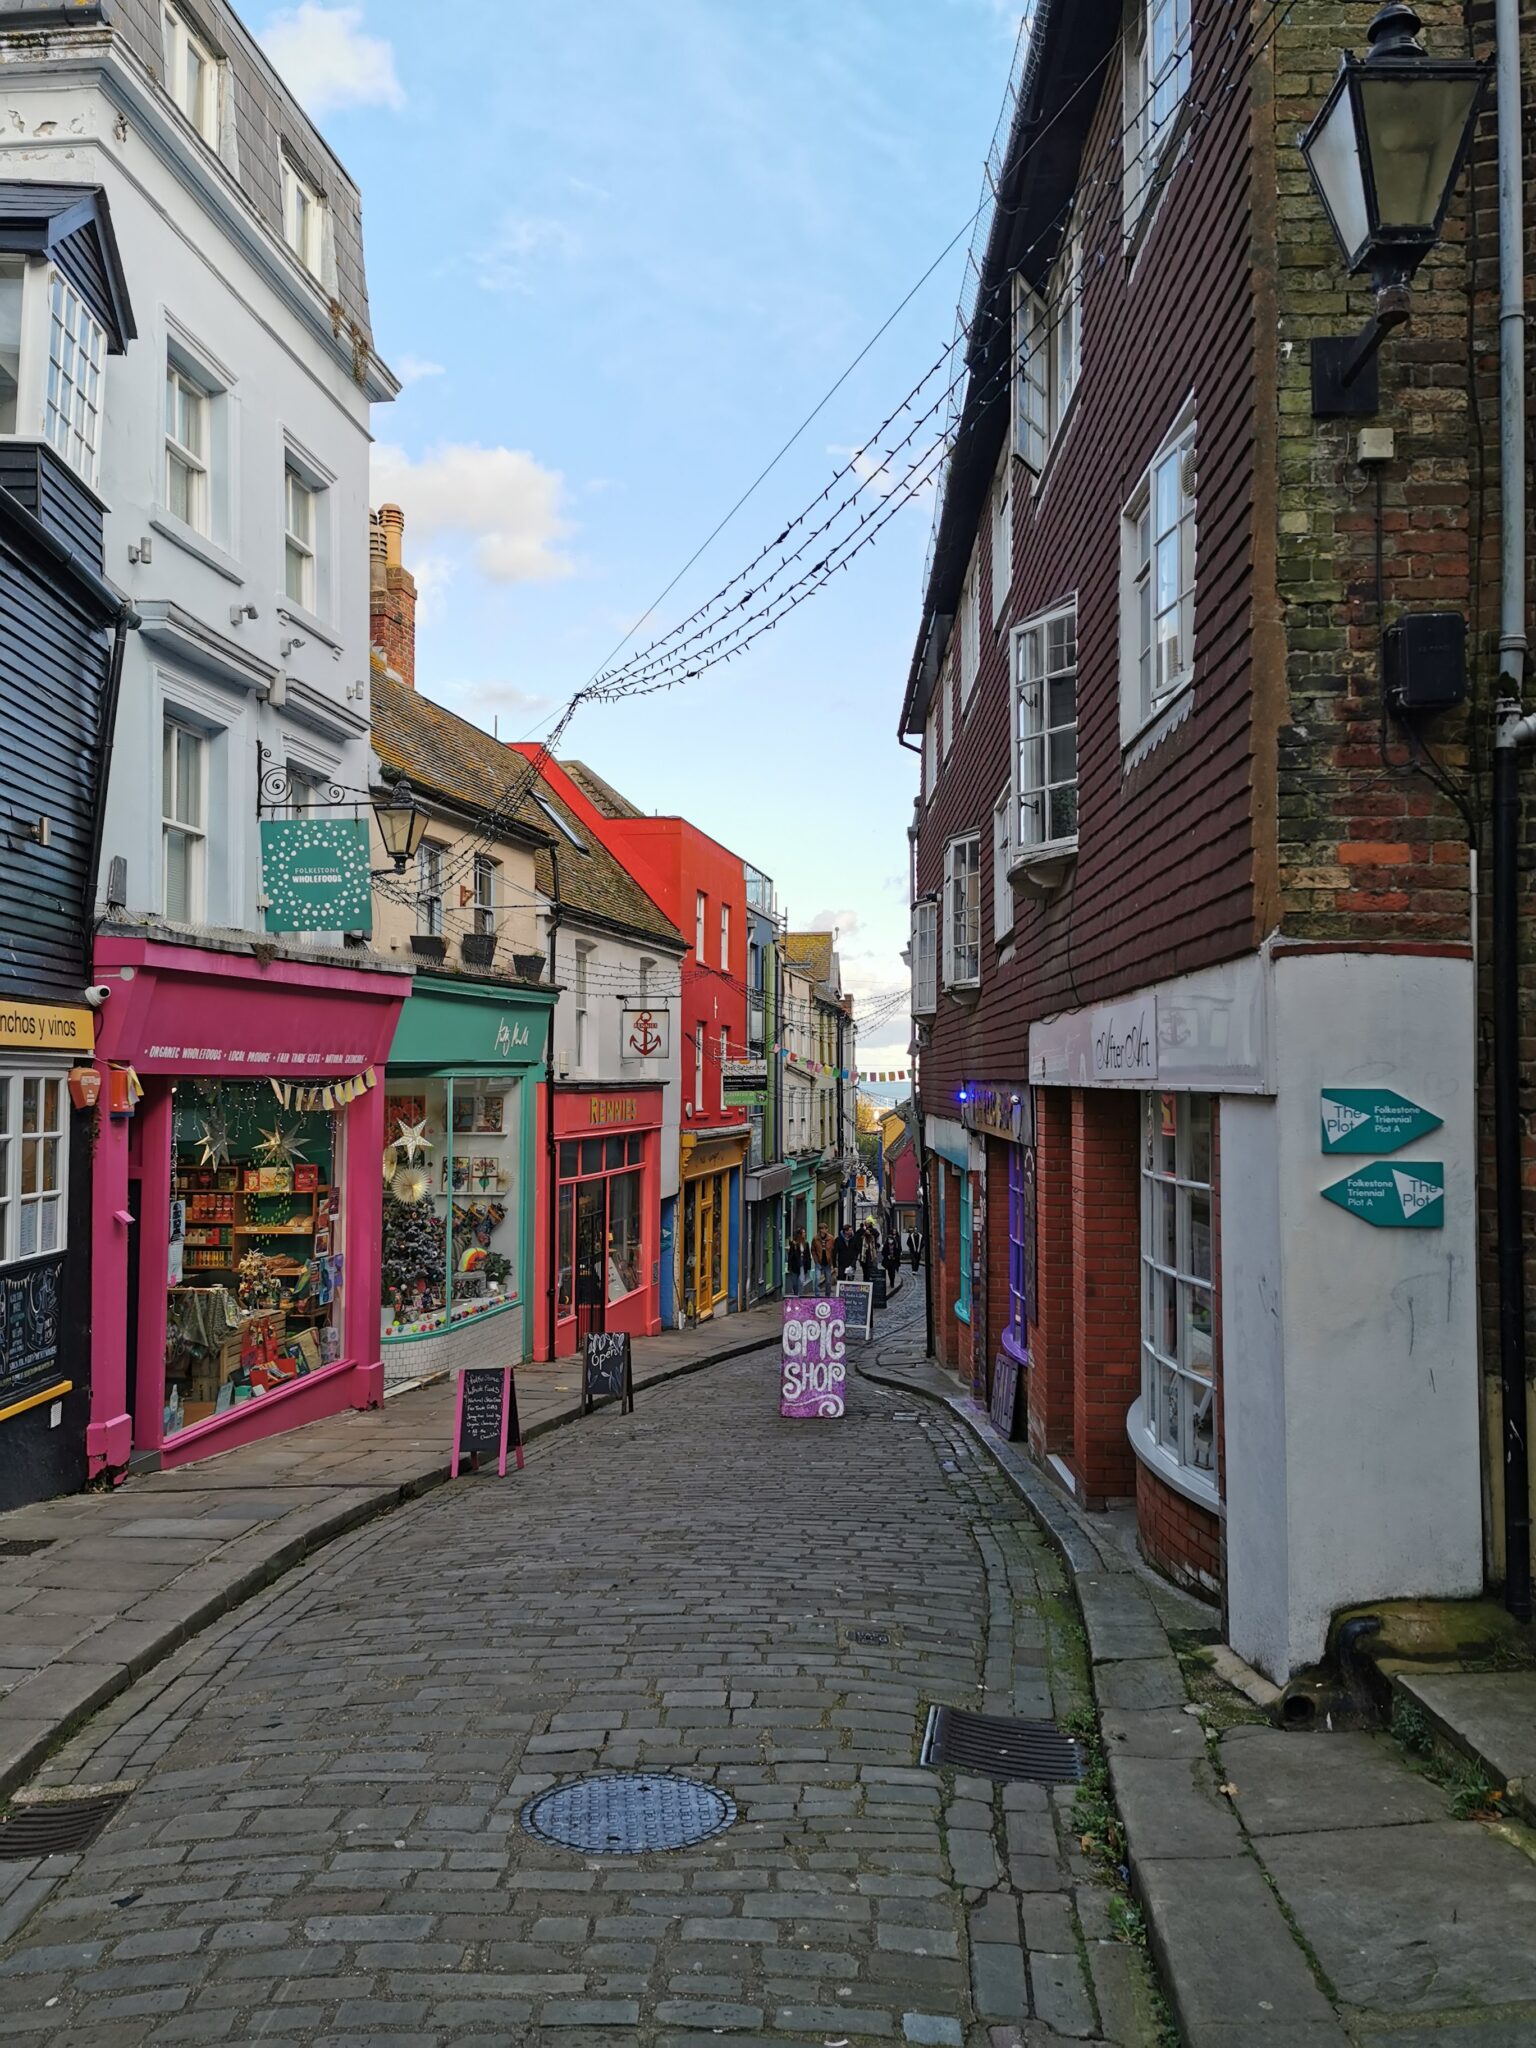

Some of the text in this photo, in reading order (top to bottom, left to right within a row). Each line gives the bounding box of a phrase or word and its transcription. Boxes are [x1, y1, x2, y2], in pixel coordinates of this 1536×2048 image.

[292, 874, 342, 883] WHOLEFOODS
[38, 1018, 45, 1041] y
[48, 1014, 77, 1037] vinos
[1095, 1010, 1150, 1070] After Art
[149, 1046, 181, 1059] ORGANIC
[182, 1047, 222, 1061] WHOLEFOODS
[228, 1050, 246, 1062] LOCAL
[590, 1097, 637, 1127] RENNIES
[1333, 1105, 1362, 1119] The
[1374, 1105, 1420, 1114] Folkestone
[1374, 1115, 1412, 1123] Triennial
[1327, 1120, 1355, 1133] Plot
[1375, 1125, 1401, 1133] Plot A
[1347, 1179, 1393, 1188] Folkestone
[1409, 1180, 1438, 1193] The
[1348, 1189, 1385, 1197] Triennial
[1403, 1193, 1431, 1207] Plot
[782, 1362, 846, 1399] SHOP
